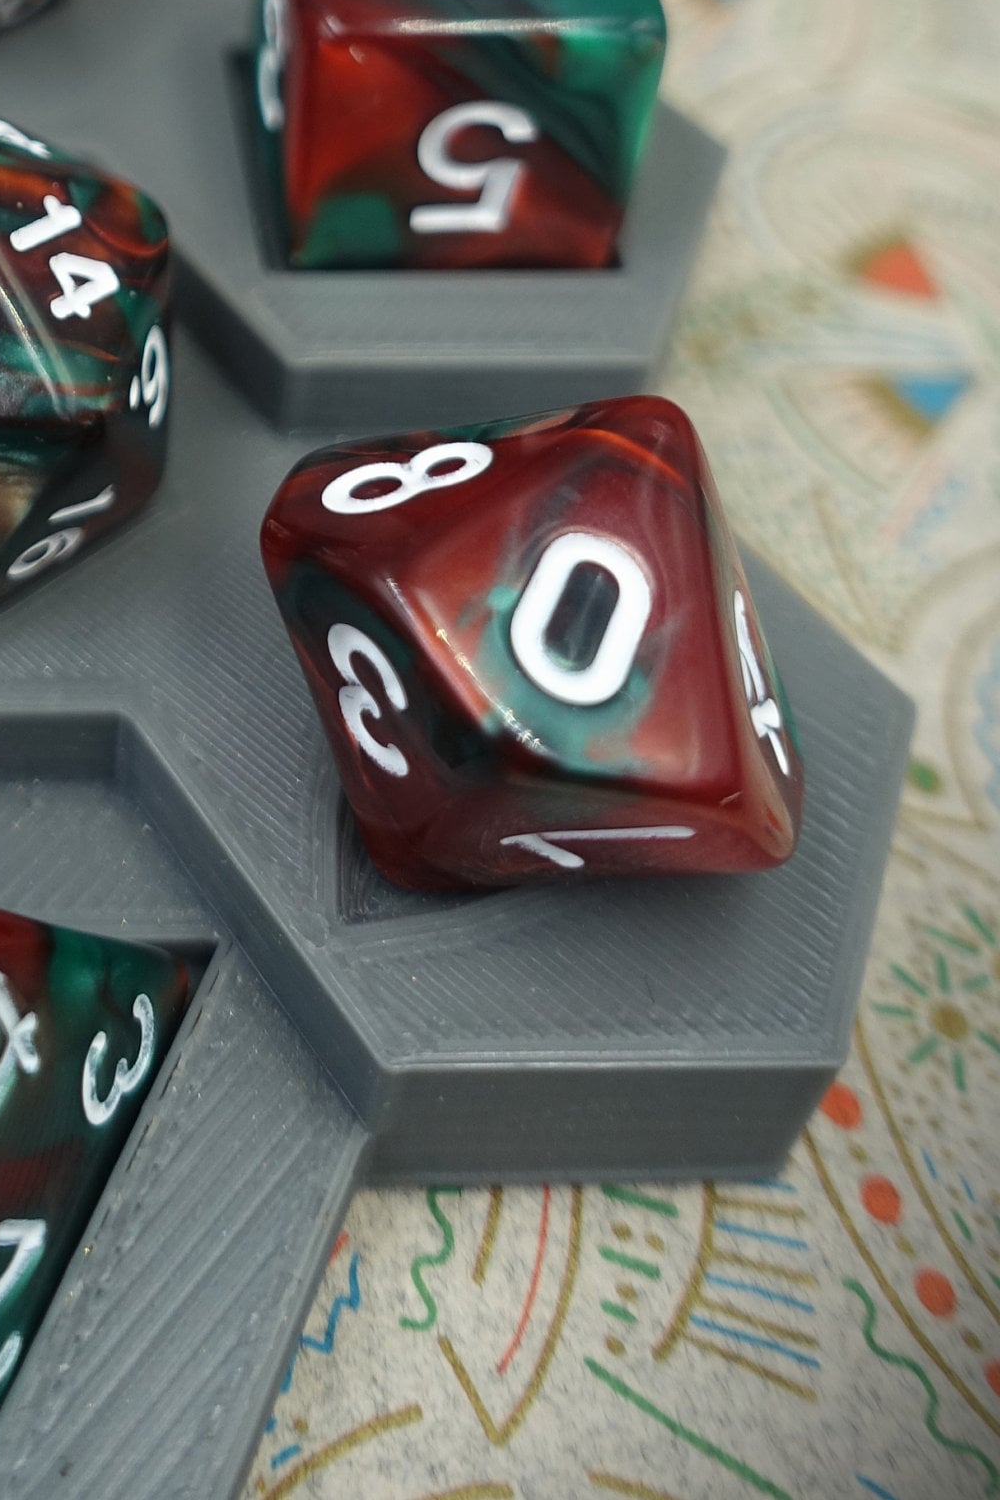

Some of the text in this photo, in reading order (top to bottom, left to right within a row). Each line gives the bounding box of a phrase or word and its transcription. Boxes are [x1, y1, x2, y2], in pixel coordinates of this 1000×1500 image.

[408, 100, 538, 233] 5
[9, 195, 119, 320] 14
[6, 484, 115, 581] 16
[321, 442, 494, 515] 8
[510, 532, 651, 706] 0
[327, 623, 409, 777] 3
[499, 826, 696, 869] 1
[82, 994, 154, 1126] 3
